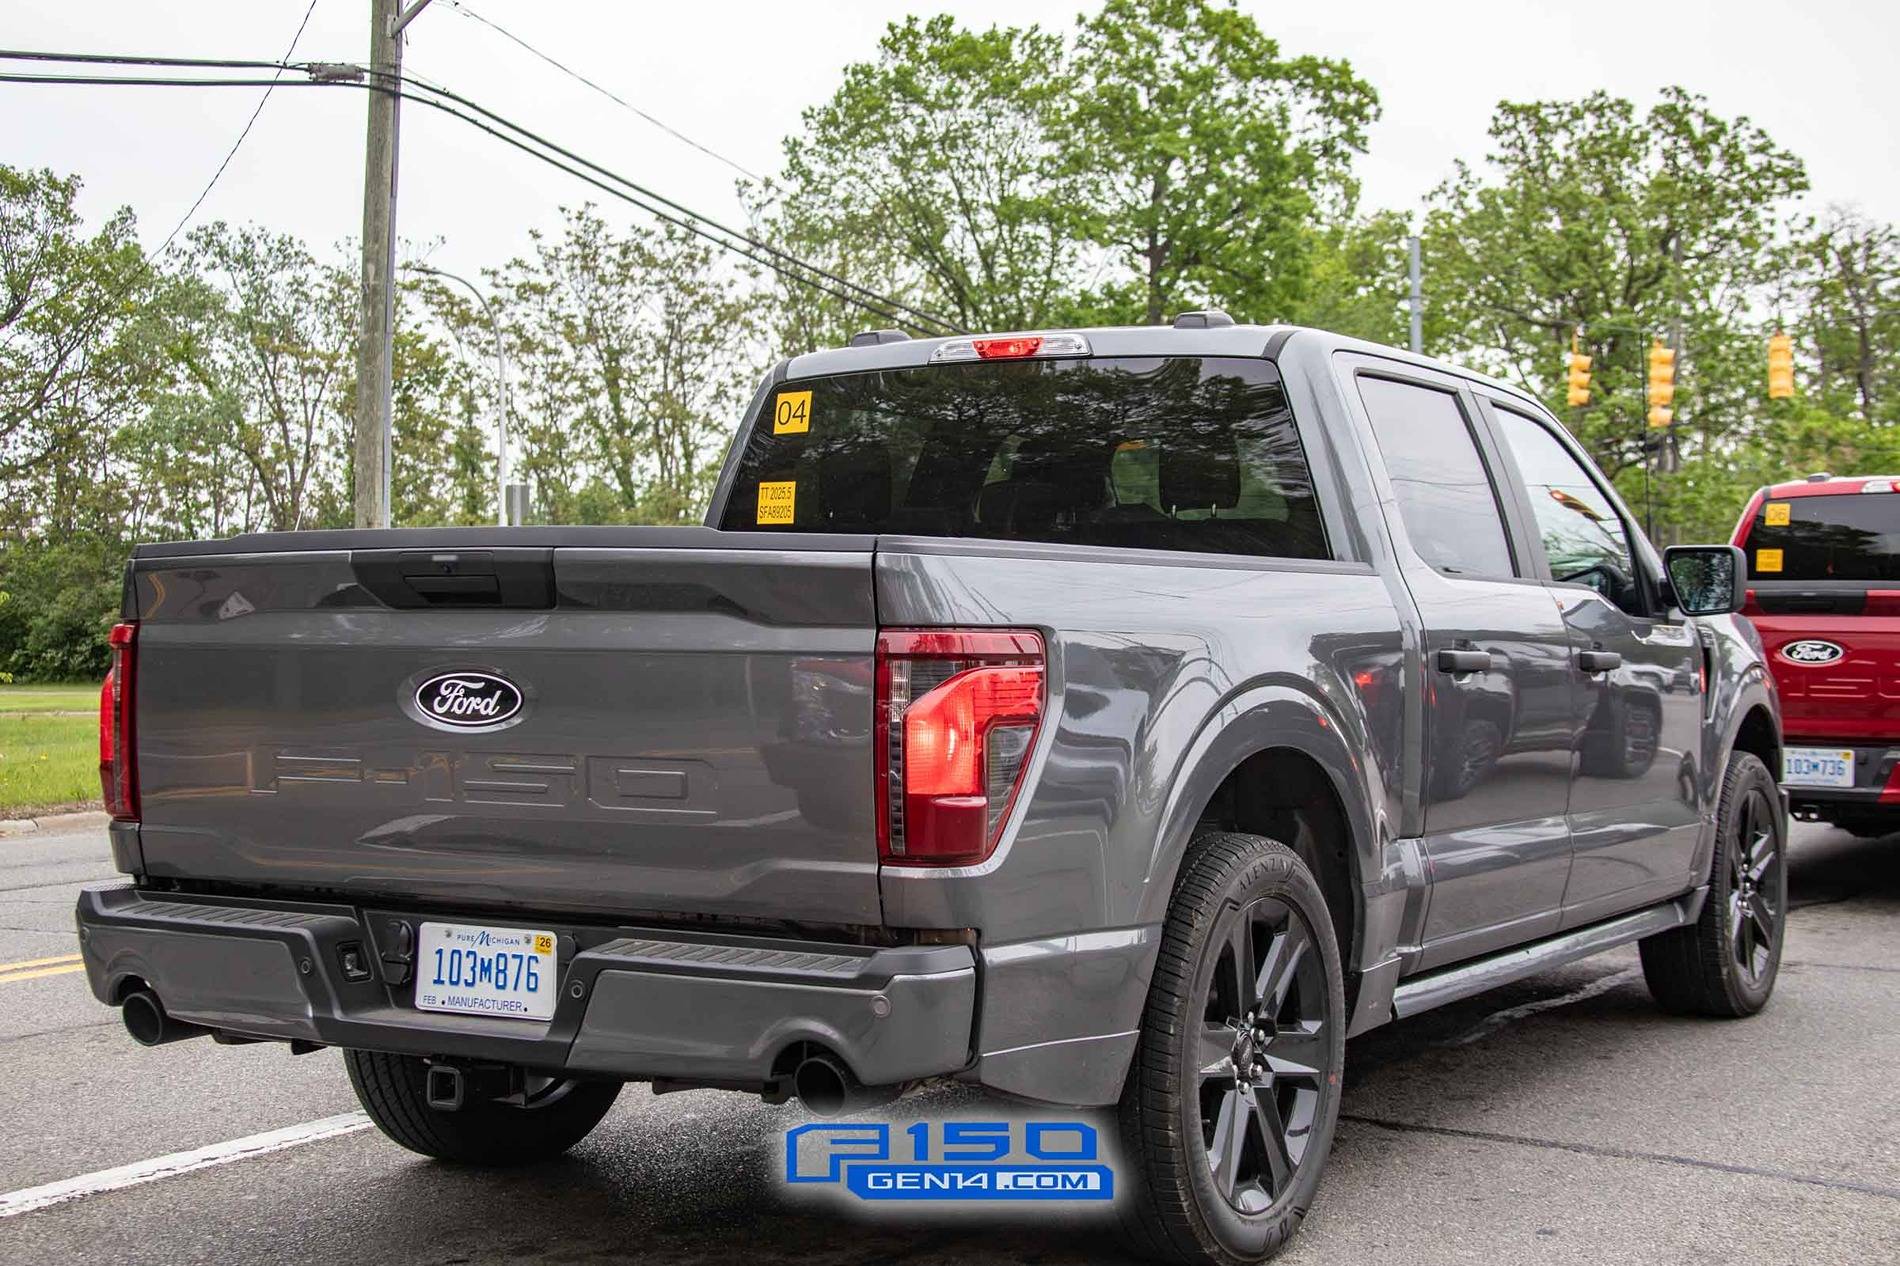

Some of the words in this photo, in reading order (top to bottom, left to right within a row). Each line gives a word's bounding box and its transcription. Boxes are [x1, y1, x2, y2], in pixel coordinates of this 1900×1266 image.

[778, 400, 806, 425] 04
[761, 487, 770, 500] TT
[1792, 643, 1833, 660] Ford
[433, 679, 503, 716] Ford
[457, 934, 475, 943] PURE
[471, 931, 521, 948] MICHIGAN
[540, 937, 551, 949] 26
[433, 948, 540, 993] 103M876
[423, 995, 437, 1005] FEB
[447, 996, 523, 1012] MANUFACTURER
